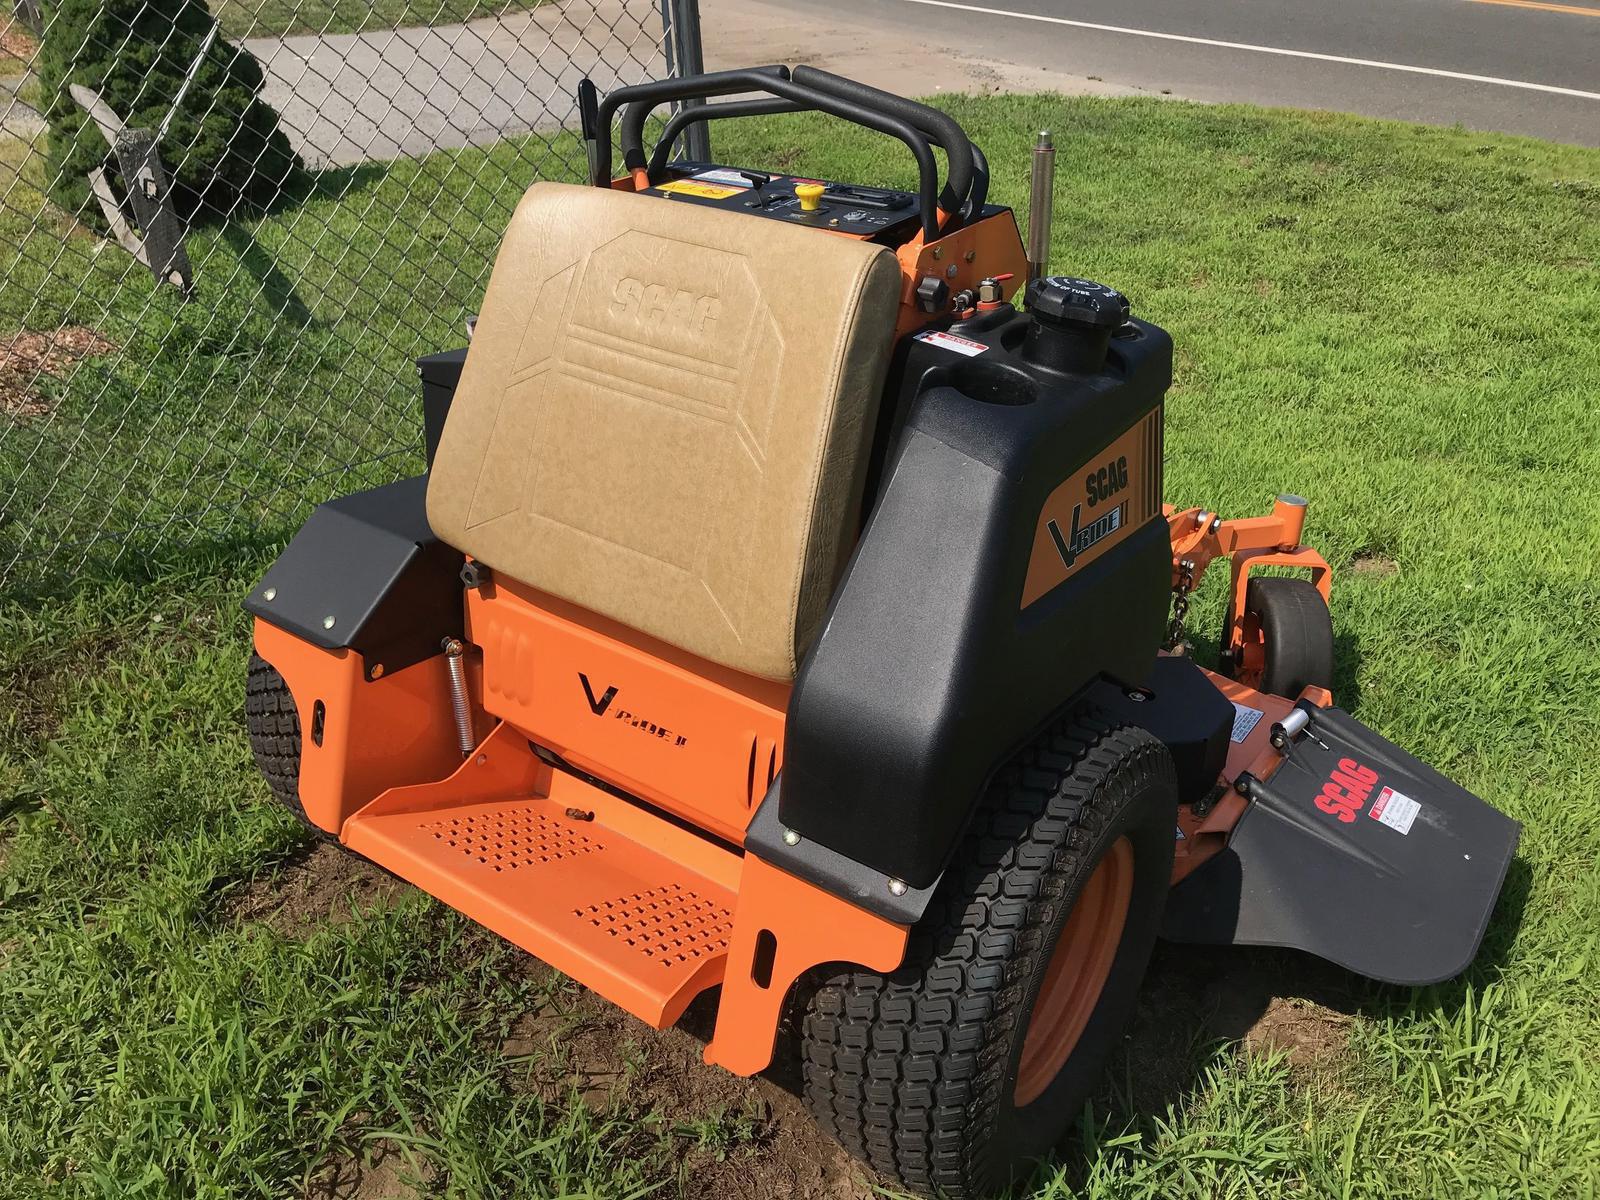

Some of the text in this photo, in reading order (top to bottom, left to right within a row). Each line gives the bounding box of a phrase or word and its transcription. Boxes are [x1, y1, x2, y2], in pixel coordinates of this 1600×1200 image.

[609, 275, 721, 336] SCAG
[1086, 455, 1128, 508] SCAG
[1313, 757, 1380, 823] SCAG
